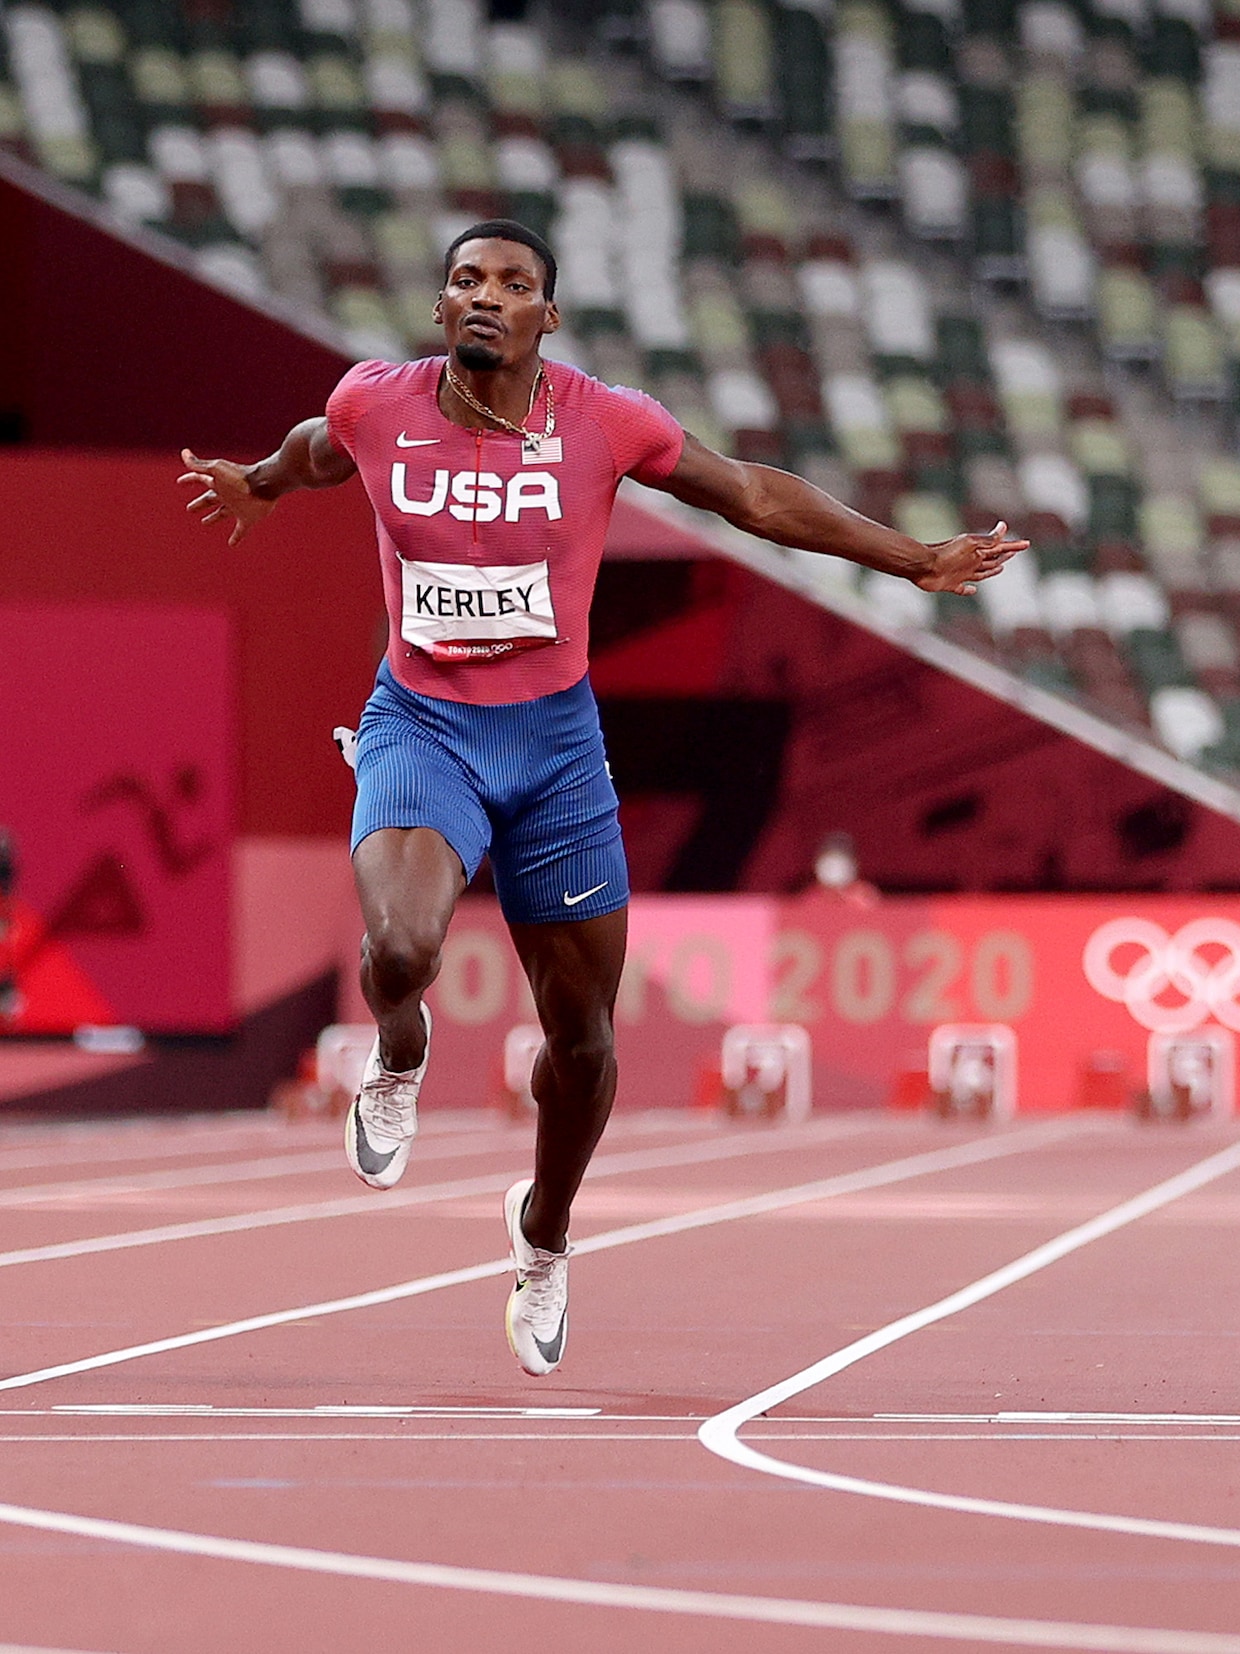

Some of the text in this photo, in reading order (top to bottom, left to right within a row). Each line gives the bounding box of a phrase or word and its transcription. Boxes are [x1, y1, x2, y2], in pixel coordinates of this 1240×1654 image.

[391, 462, 563, 523] USA
[415, 583, 535, 617] KERLEY
[768, 926, 1034, 1025] 2020
